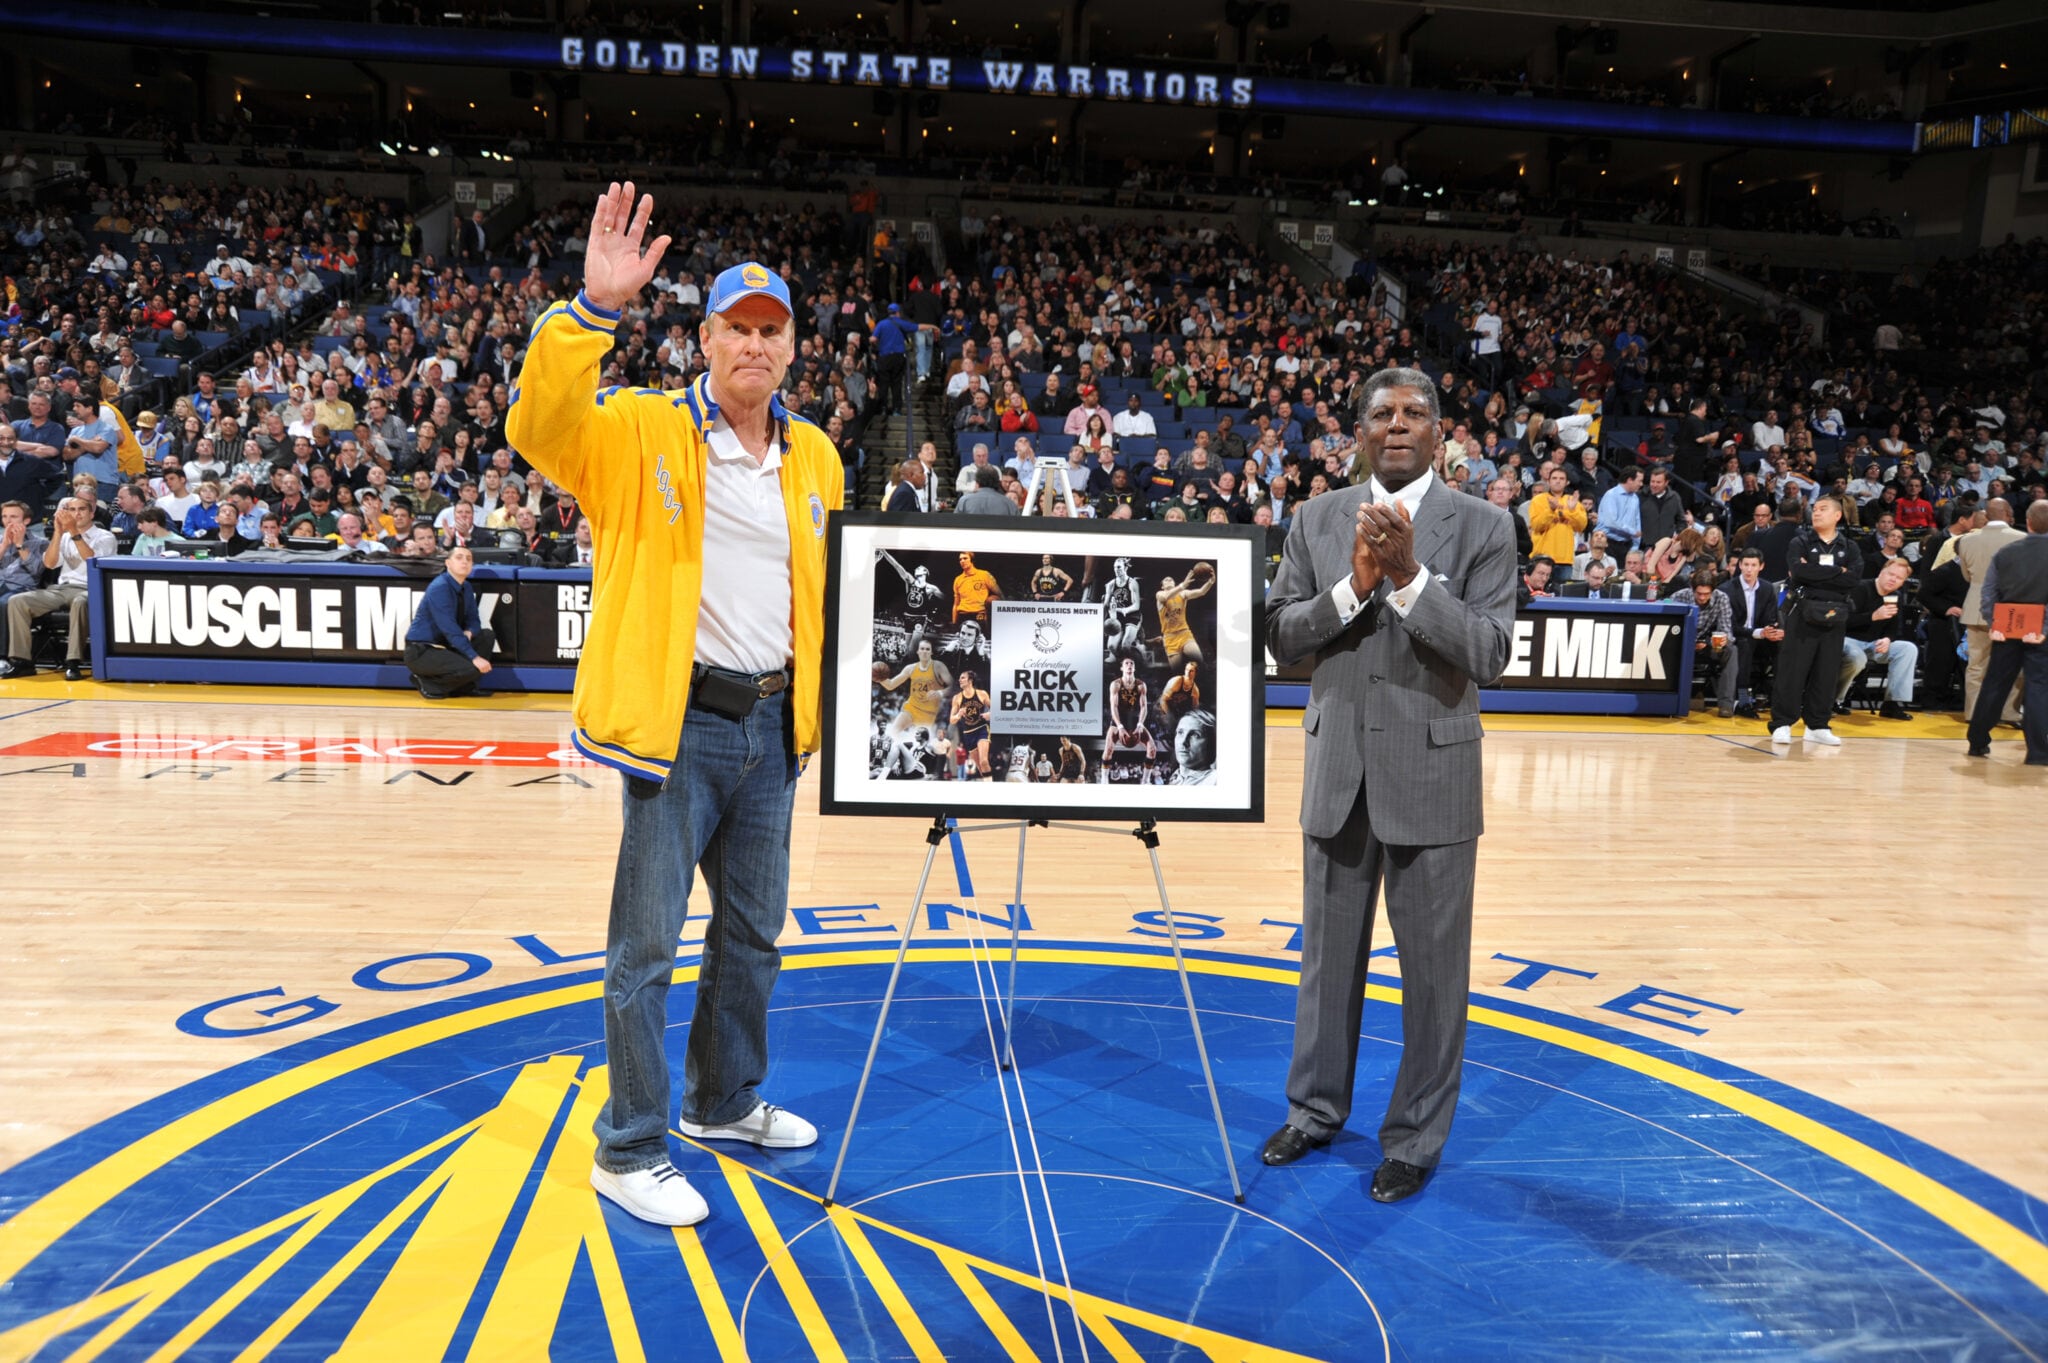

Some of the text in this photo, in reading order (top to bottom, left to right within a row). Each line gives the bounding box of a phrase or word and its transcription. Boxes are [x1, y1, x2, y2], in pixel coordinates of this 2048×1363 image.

[561, 37, 1254, 105] GOLDEN STATE WARRIORS
[457, 191, 474, 201] 127
[1316, 234, 1332, 243] 102
[655, 454, 683, 525] 1967
[112, 578, 343, 650] MUSCLE
[1014, 669, 1078, 690] RICK
[1000, 691, 1092, 712] BARRY
[0, 762, 597, 789] ARENA
